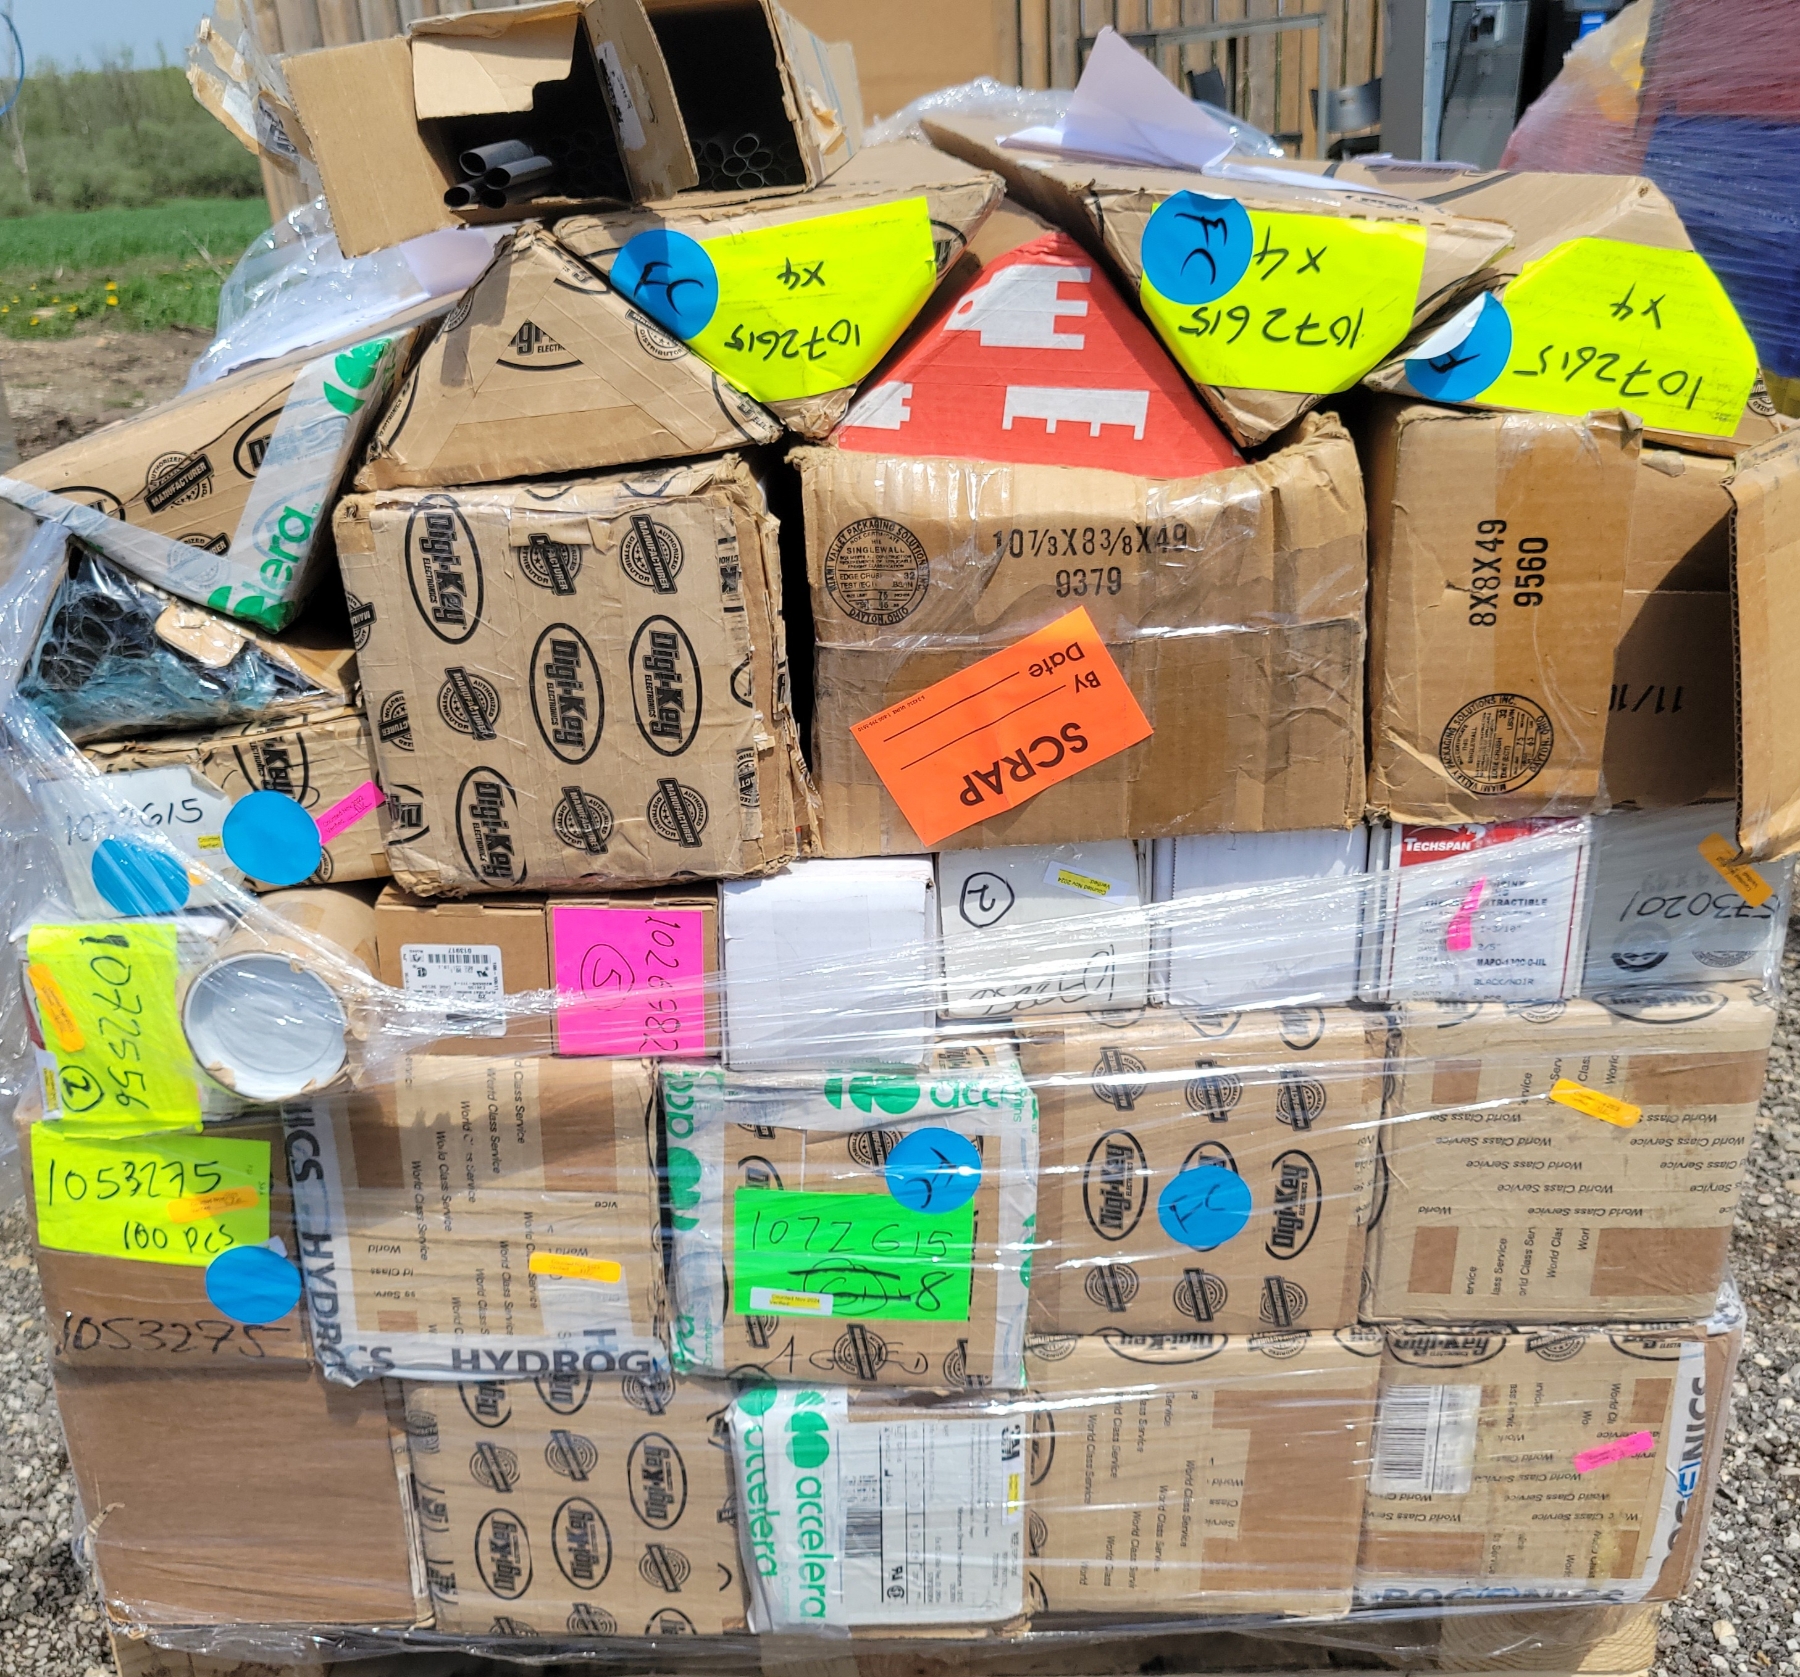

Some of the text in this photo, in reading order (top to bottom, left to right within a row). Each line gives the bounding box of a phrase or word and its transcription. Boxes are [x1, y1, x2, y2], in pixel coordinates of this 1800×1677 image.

[725, 320, 860, 361] 1072615
[1178, 306, 1364, 349] 1072615
[1512, 345, 1702, 410] 1072615
[151, 462, 206, 507] MANUFACTURER
[623, 536, 650, 582] DISTRIBUTOR
[637, 520, 669, 589] MANUFACTURER
[658, 529, 678, 570] AUTHORIZED
[829, 535, 848, 562] VALLEY
[847, 520, 895, 536] PACKAGING
[897, 528, 928, 570] SOLUTIONS
[419, 512, 467, 626] Digi-Key
[423, 557, 437, 604] ELECTRONICS
[904, 572, 915, 580] 32
[1055, 567, 1122, 598] 9379
[1468, 519, 1508, 627] 8X8X49
[1513, 537, 1548, 608] 9560
[887, 608, 908, 622] OHIO
[1028, 642, 1085, 678] Date
[453, 672, 490, 735] MANUFACTURER
[473, 679, 494, 717] AUTHORIZED
[544, 638, 587, 747] Digi-Key
[642, 630, 684, 742] Digi-Key
[644, 675, 656, 718] ELECTRONICS
[1074, 670, 1101, 694] By
[442, 687, 469, 730] DISTRIBUTOR
[547, 682, 559, 726] ELECTRONICS
[959, 722, 1089, 807] SCRAP
[1442, 696, 1517, 792] MIAMI VALLEY PACKAGING SOLUTIONS INC.
[569, 791, 603, 853] MANUFACTURER
[589, 799, 608, 835] AUTHORIZED
[651, 796, 677, 838] DISTRIBUTOR
[664, 783, 694, 844] MANUFACTURER
[684, 790, 702, 827] AUTHORIZED
[469, 781, 515, 882] Digi-Key
[473, 822, 487, 862] ELECTRONICS
[1404, 838, 1471, 851] TECHSPAN
[592, 958, 622, 988] 5
[1474, 978, 1534, 986] BLACK/NOIR
[487, 1067, 501, 1174] World Class Service
[1450, 1113, 1521, 1122] World Class
[1645, 1113, 1716, 1123] World Class
[1435, 1136, 1552, 1146] World Class Service
[1630, 1136, 1745, 1147] World Class Service
[49, 1160, 222, 1206] 1053275
[1100, 1141, 1134, 1229] Digi-Key
[1466, 1161, 1582, 1170] World Class Service
[1660, 1161, 1737, 1170] Class Service
[1272, 1160, 1309, 1249] Digi-Key
[1497, 1184, 1613, 1193] World Class Service
[1689, 1184, 1732, 1193] Service
[412, 1161, 428, 1261] World Class Service
[1418, 1206, 1451, 1215] World
[1528, 1207, 1643, 1217] World Class Service
[124, 1220, 168, 1250] 100
[1495, 1238, 1507, 1268] Service
[1523, 1242, 1533, 1269] Class
[1547, 1249, 1559, 1279] World
[501, 1241, 514, 1335] World Class Service
[56, 1311, 291, 1358] 1053275
[1164, 1392, 1175, 1427] Service
[1110, 1417, 1122, 1479] Class Service
[1135, 1420, 1146, 1453] Service
[641, 1442, 675, 1521] Digi-Key
[1083, 1442, 1095, 1504] Class Service
[1212, 1478, 1244, 1487] World
[1180, 1459, 1195, 1547] World Class Service
[567, 1505, 600, 1580] Digi-Key
[795, 1476, 835, 1619] accelera
[1130, 1510, 1142, 1562] World Class
[1153, 1484, 1168, 1573] World Class Service
[489, 1517, 523, 1592] Digi-Key
[1104, 1535, 1115, 1587] World Class
